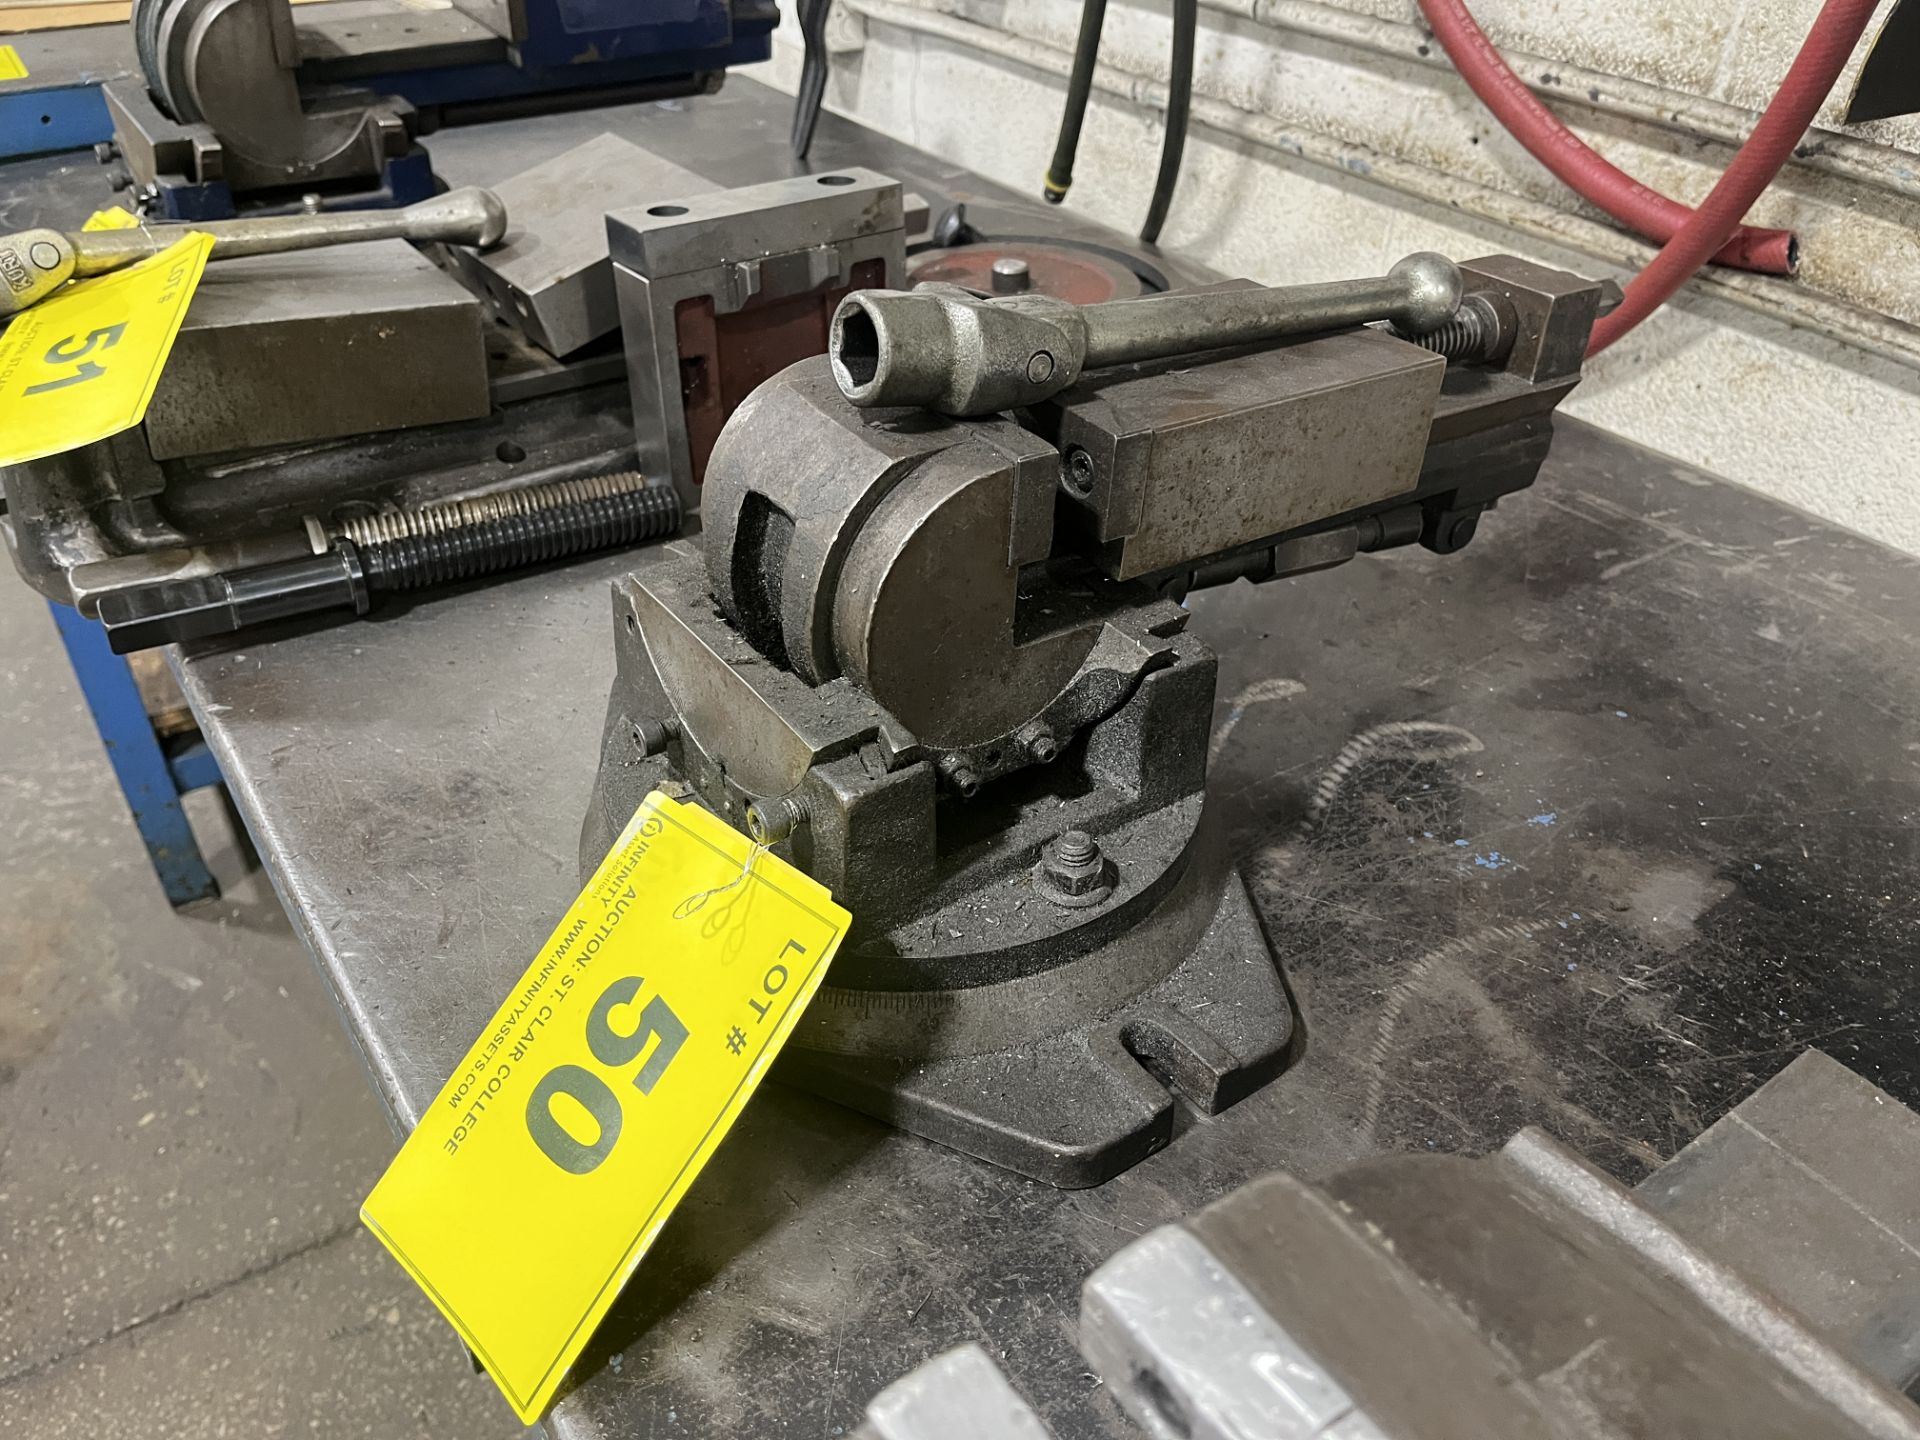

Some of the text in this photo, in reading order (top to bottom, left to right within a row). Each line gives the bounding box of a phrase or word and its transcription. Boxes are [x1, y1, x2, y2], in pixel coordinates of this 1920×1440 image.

[21, 321, 129, 397] 51
[592, 835, 640, 899] Asset Solutions
[601, 841, 650, 908] INFINITY
[443, 885, 637, 1156] AUCTION: ST. CLAIR COLLEGE
[448, 919, 588, 1109] WWW.INFINITYASSETS.COM
[725, 938, 807, 1057] LOT #
[525, 975, 691, 1175] 50
